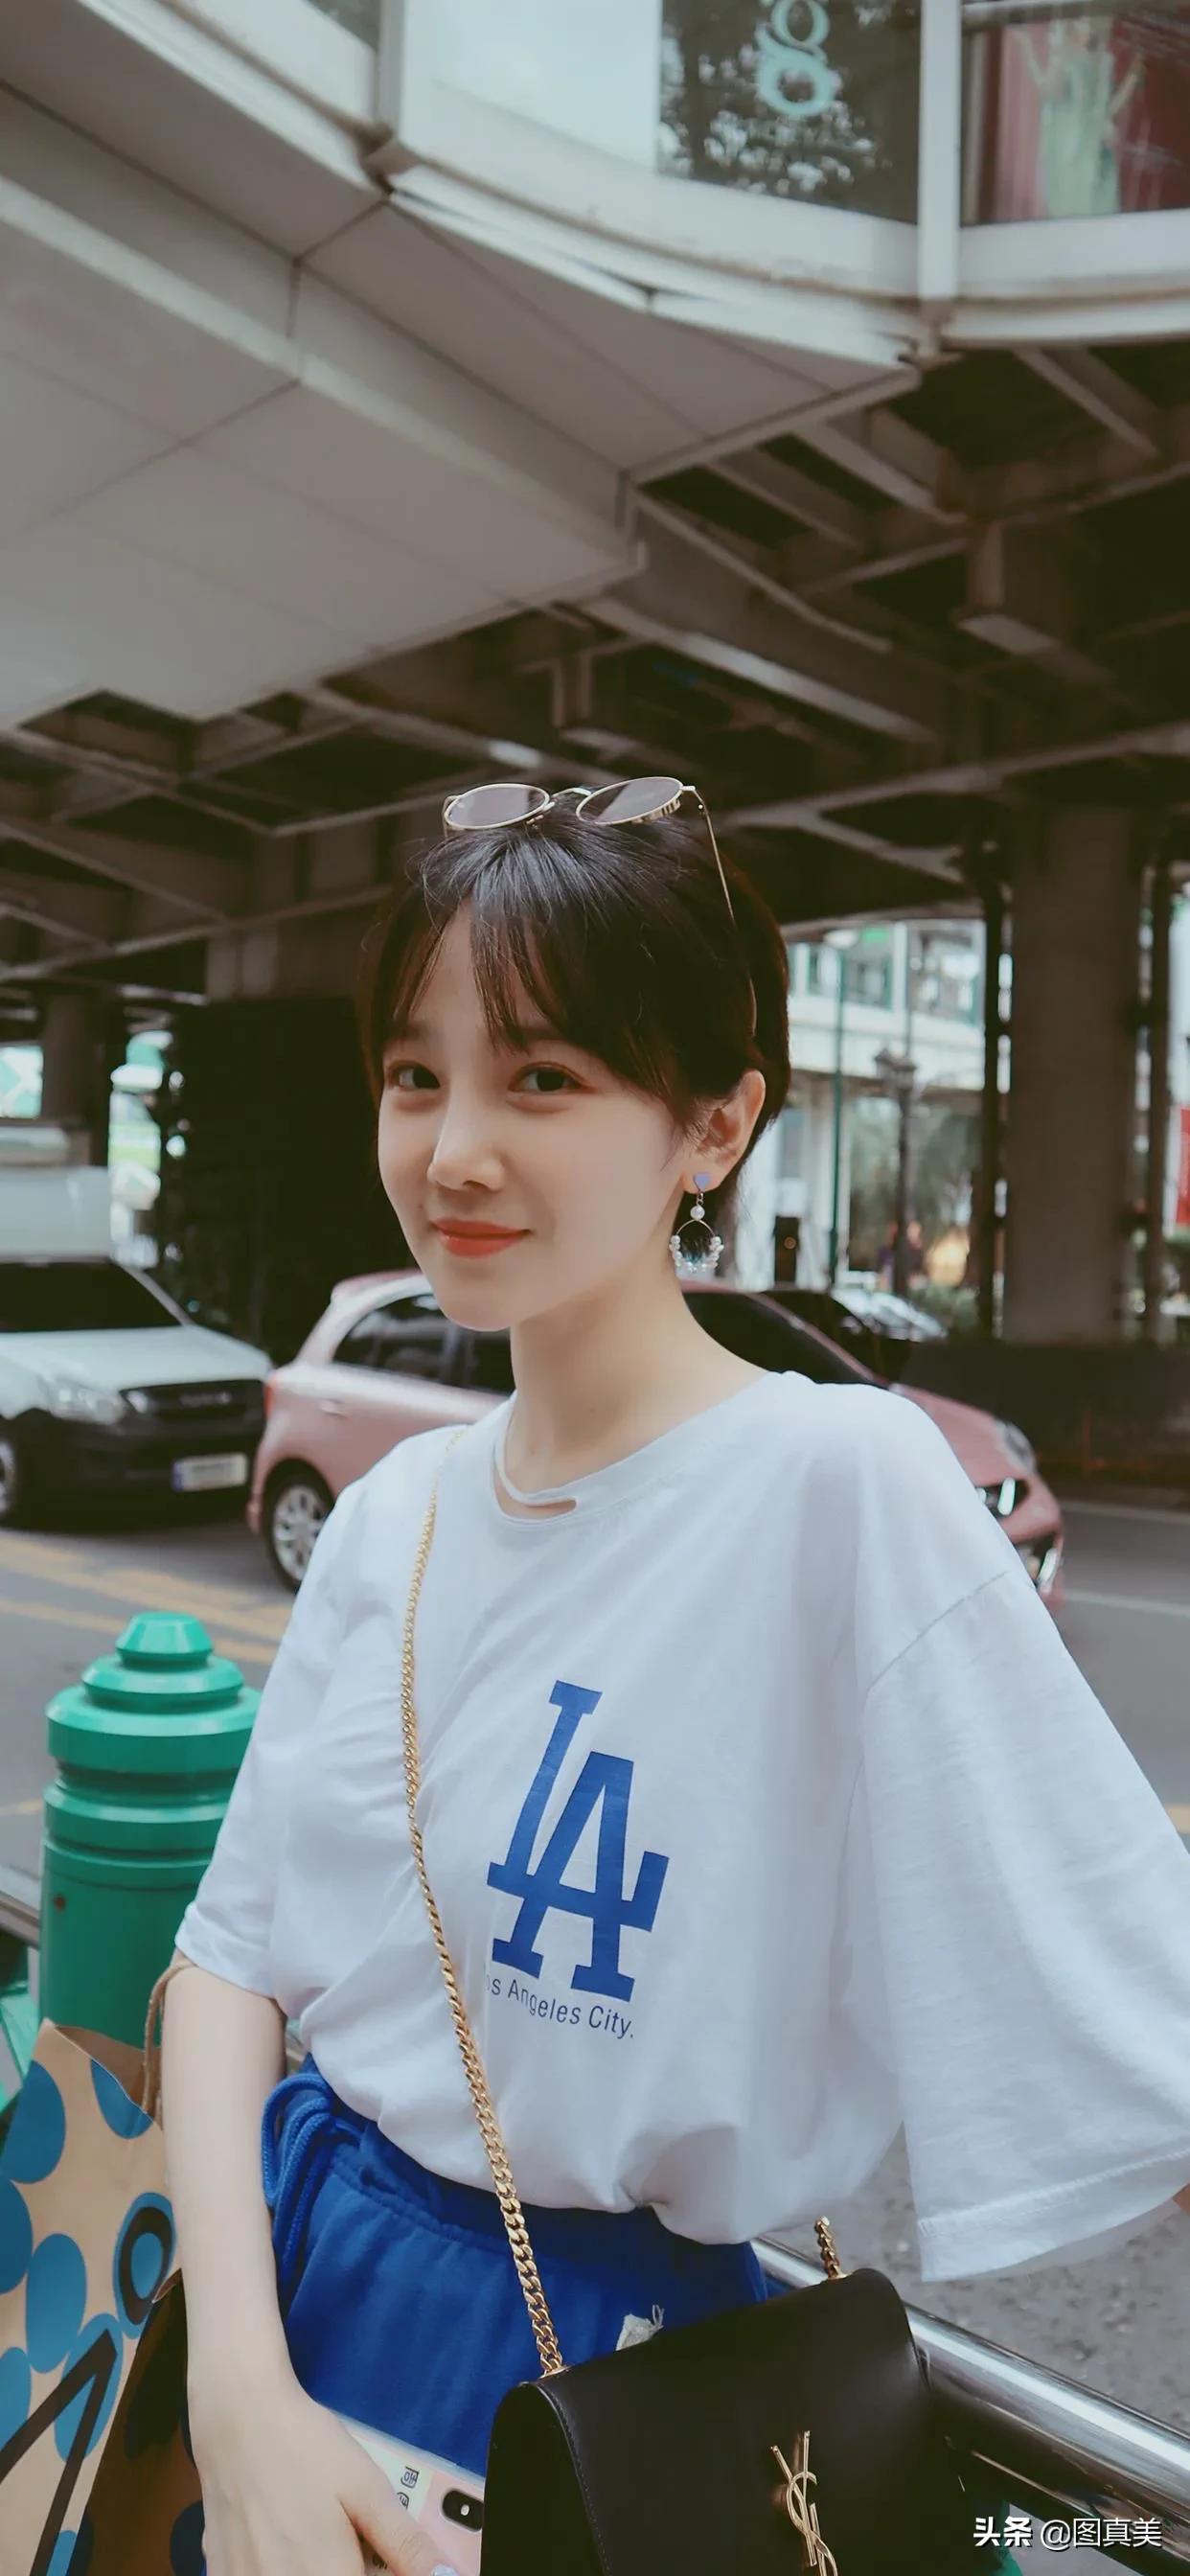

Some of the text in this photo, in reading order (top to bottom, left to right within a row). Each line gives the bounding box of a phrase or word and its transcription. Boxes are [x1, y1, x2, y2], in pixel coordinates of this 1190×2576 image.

[487, 1680, 669, 2002] LA
[508, 1979, 582, 2025] Angeles
[588, 2005, 634, 2039] City.
